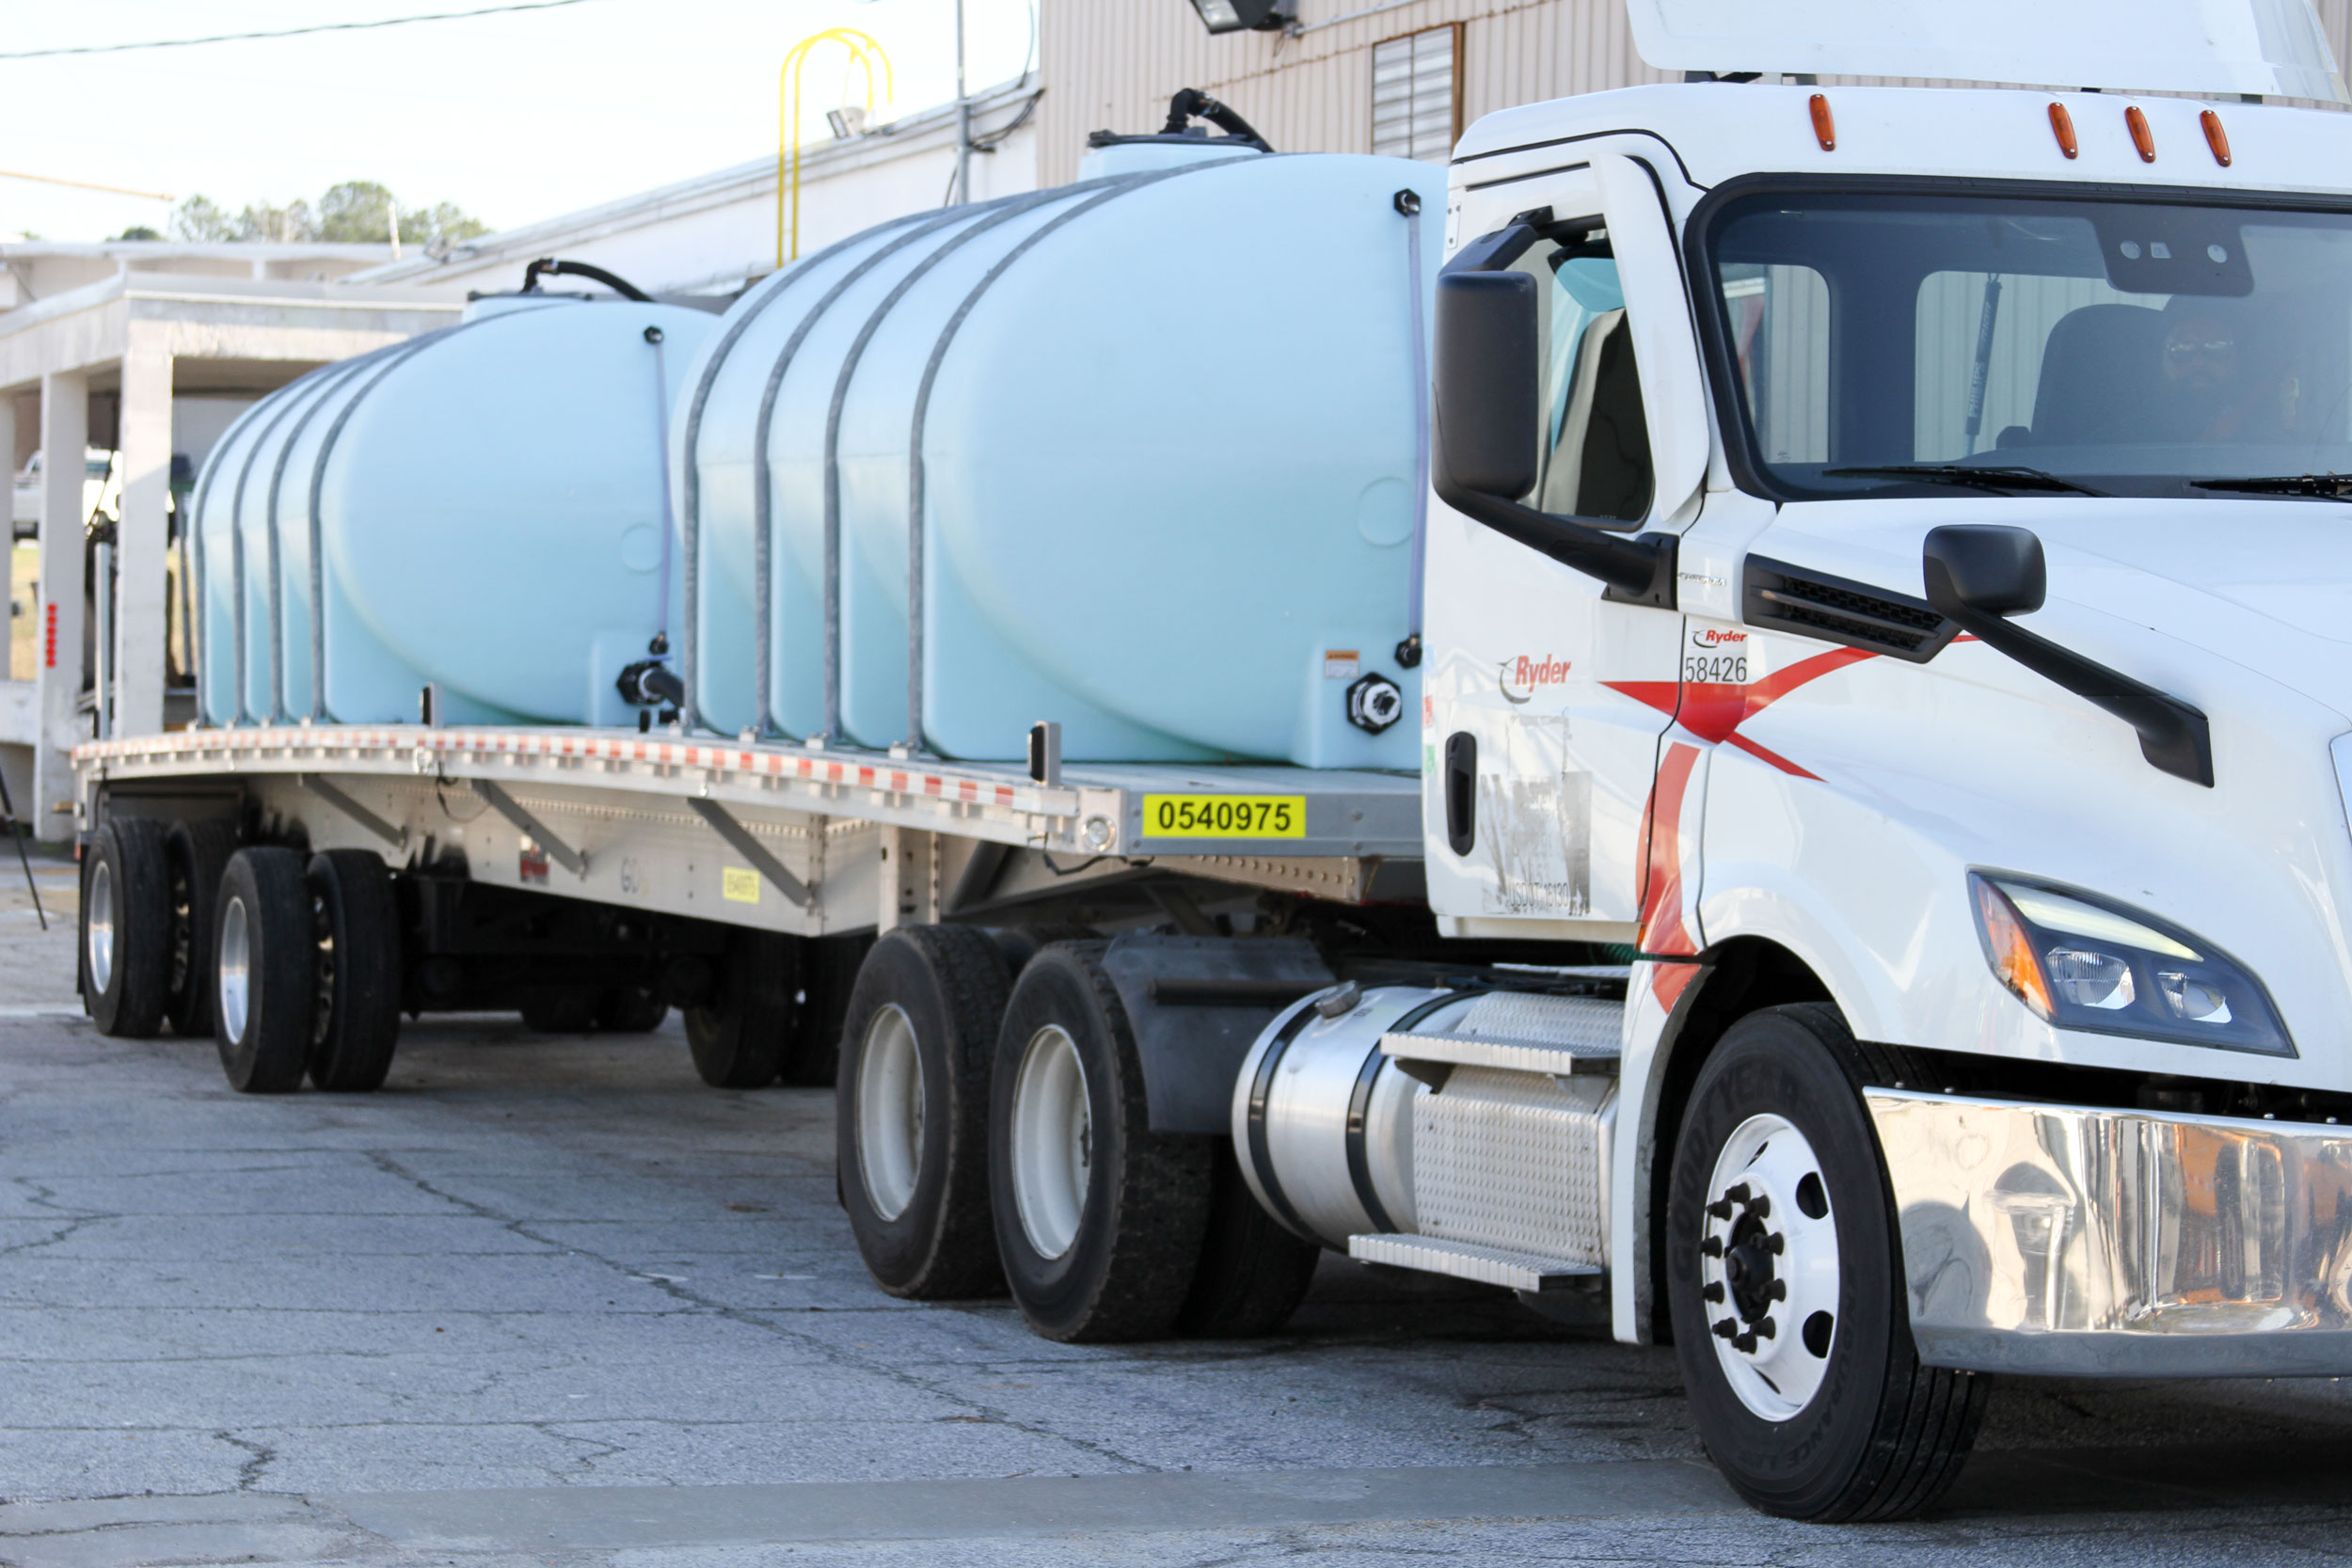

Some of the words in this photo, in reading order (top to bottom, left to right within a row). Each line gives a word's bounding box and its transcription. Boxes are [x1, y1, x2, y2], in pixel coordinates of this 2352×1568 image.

[1706, 629, 1748, 643] Ryder
[1515, 654, 1571, 693] Ryder
[1686, 657, 1747, 682] 58426
[1158, 800, 1292, 832] 0540975
